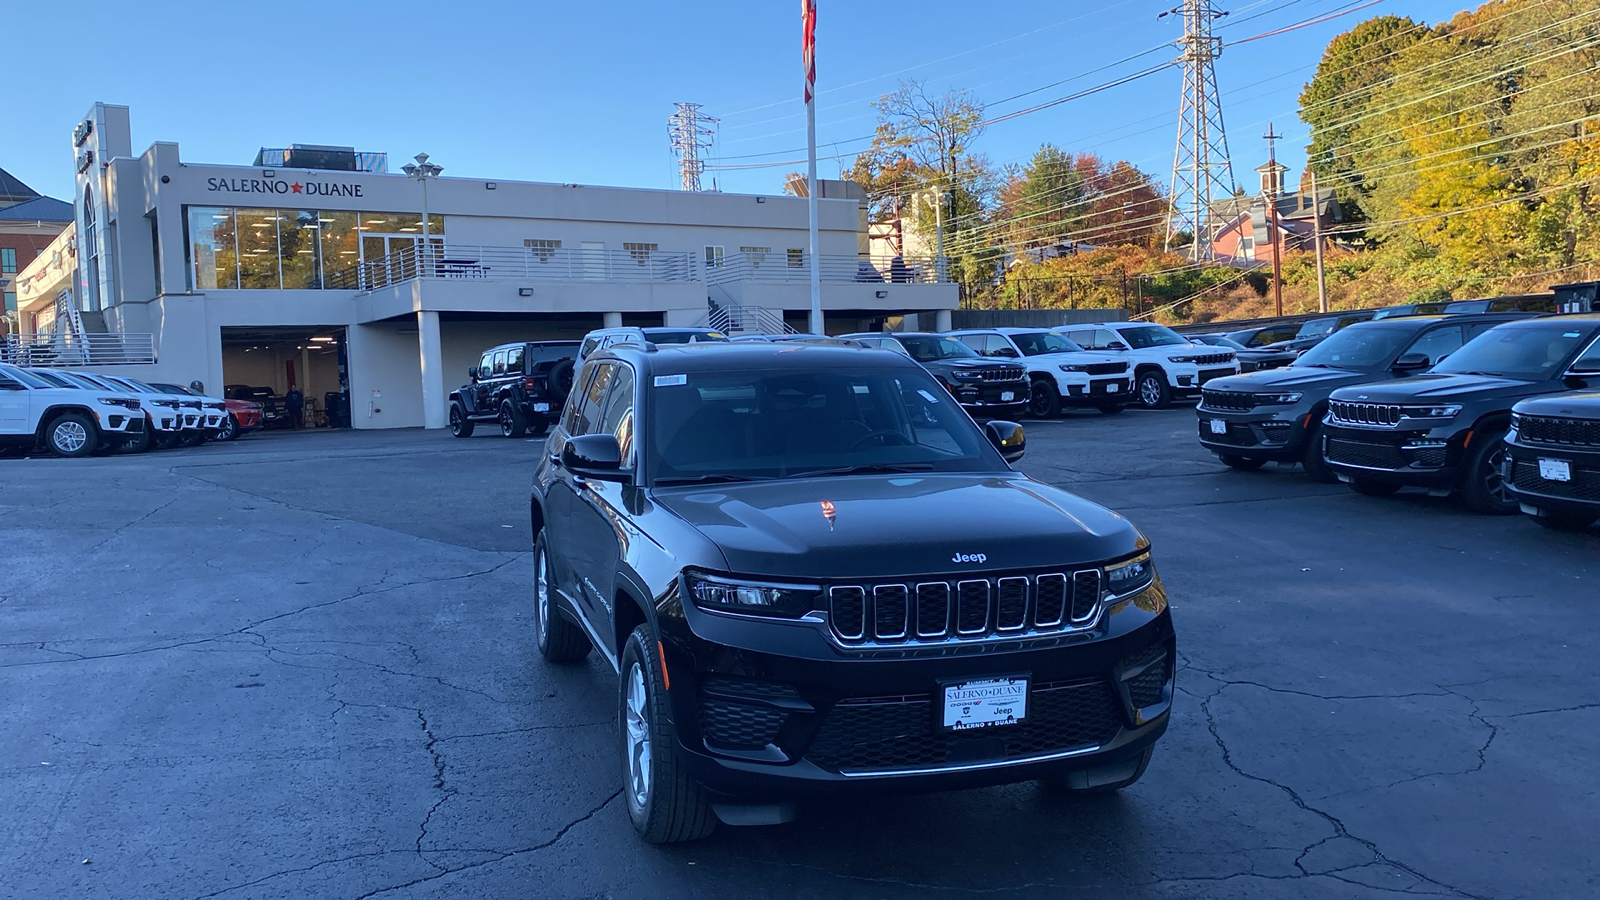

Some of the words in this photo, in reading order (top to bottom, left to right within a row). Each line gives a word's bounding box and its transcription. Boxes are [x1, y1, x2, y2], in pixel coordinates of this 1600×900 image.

[207, 177, 289, 194] SALERNO
[305, 182, 363, 198] DUANE
[951, 552, 987, 564] Jeep
[947, 688, 988, 700] SALERNO
[992, 686, 1024, 696] DUANE
[993, 707, 1013, 715] Jeep
[953, 722, 985, 730] SALERNO
